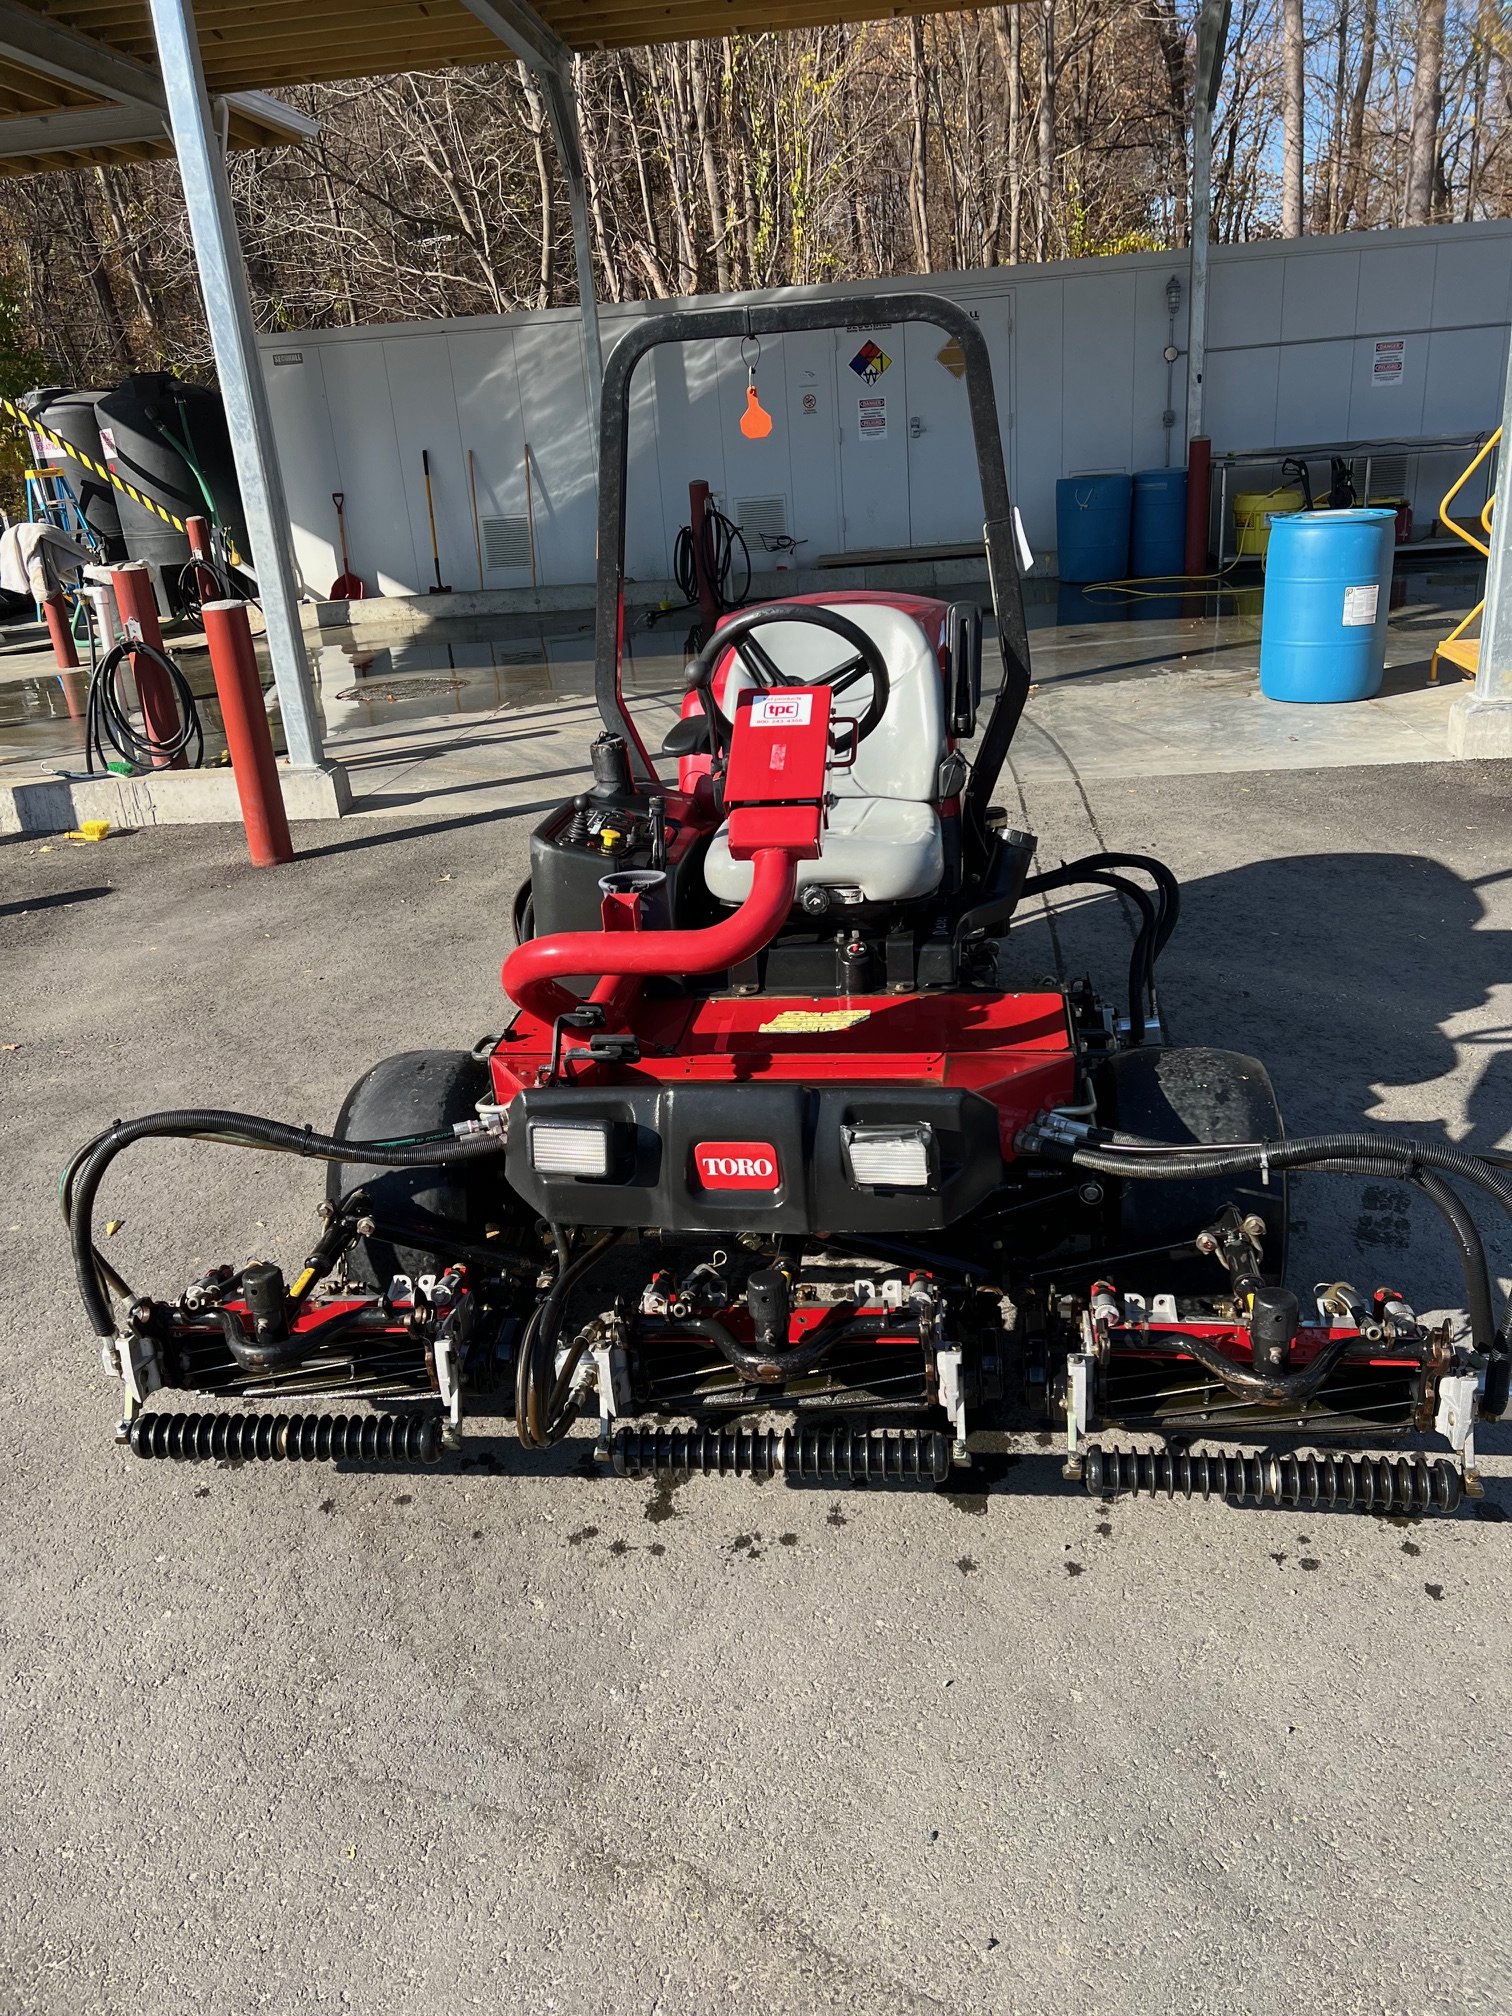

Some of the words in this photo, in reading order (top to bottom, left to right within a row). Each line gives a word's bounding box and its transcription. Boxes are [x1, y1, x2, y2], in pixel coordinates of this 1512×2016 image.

[876, 352, 884, 373] 1
[769, 705, 794, 717] tpc
[702, 1158, 773, 1177] TORO
